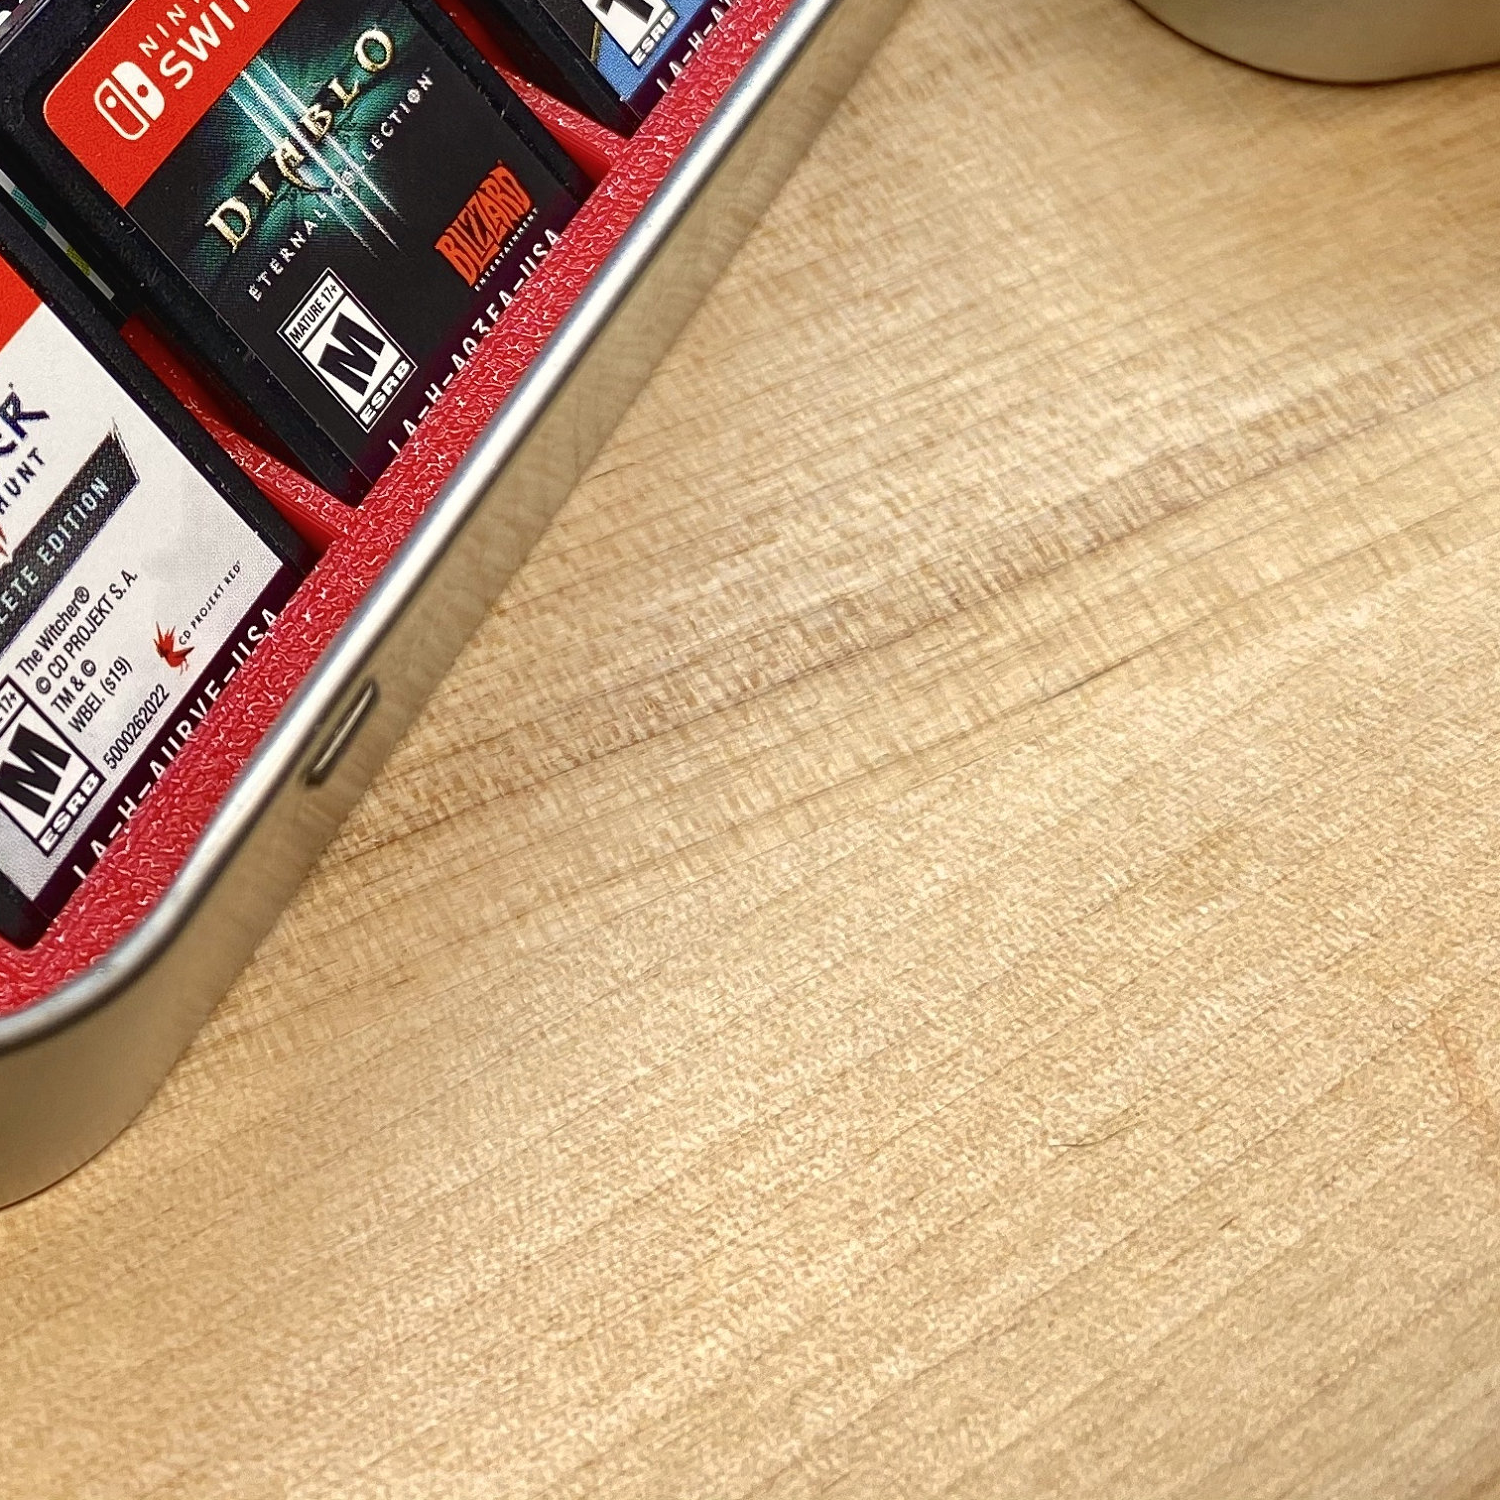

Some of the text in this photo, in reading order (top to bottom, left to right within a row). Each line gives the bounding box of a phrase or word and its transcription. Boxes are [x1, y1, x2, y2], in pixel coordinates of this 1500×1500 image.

[631, 8, 677, 65] ESRB
[204, 28, 395, 254] DIABLO
[248, 208, 328, 303] ETERNAL
[434, 164, 534, 287] BLIZZARD
[474, 206, 540, 292] ENTERTAINMENT
[288, 283, 340, 344] MATURE 17+
[317, 311, 386, 397] M
[359, 359, 411, 426] ESRB
[36, 477, 110, 566] EDITION
[15, 585, 90, 677] The Witcher®
[47, 654, 69, 679] CD
[63, 593, 114, 660] PROJEKT
[109, 582, 127, 600] S.
[120, 569, 139, 588] A.
[178, 564, 238, 646] CD PROJEKT RED
[50, 687, 76, 714] TM
[70, 675, 86, 692] &
[67, 655, 134, 734] WBEI. (s19)
[102, 683, 171, 771] 5000262022
[39, 772, 100, 852] ESRB
